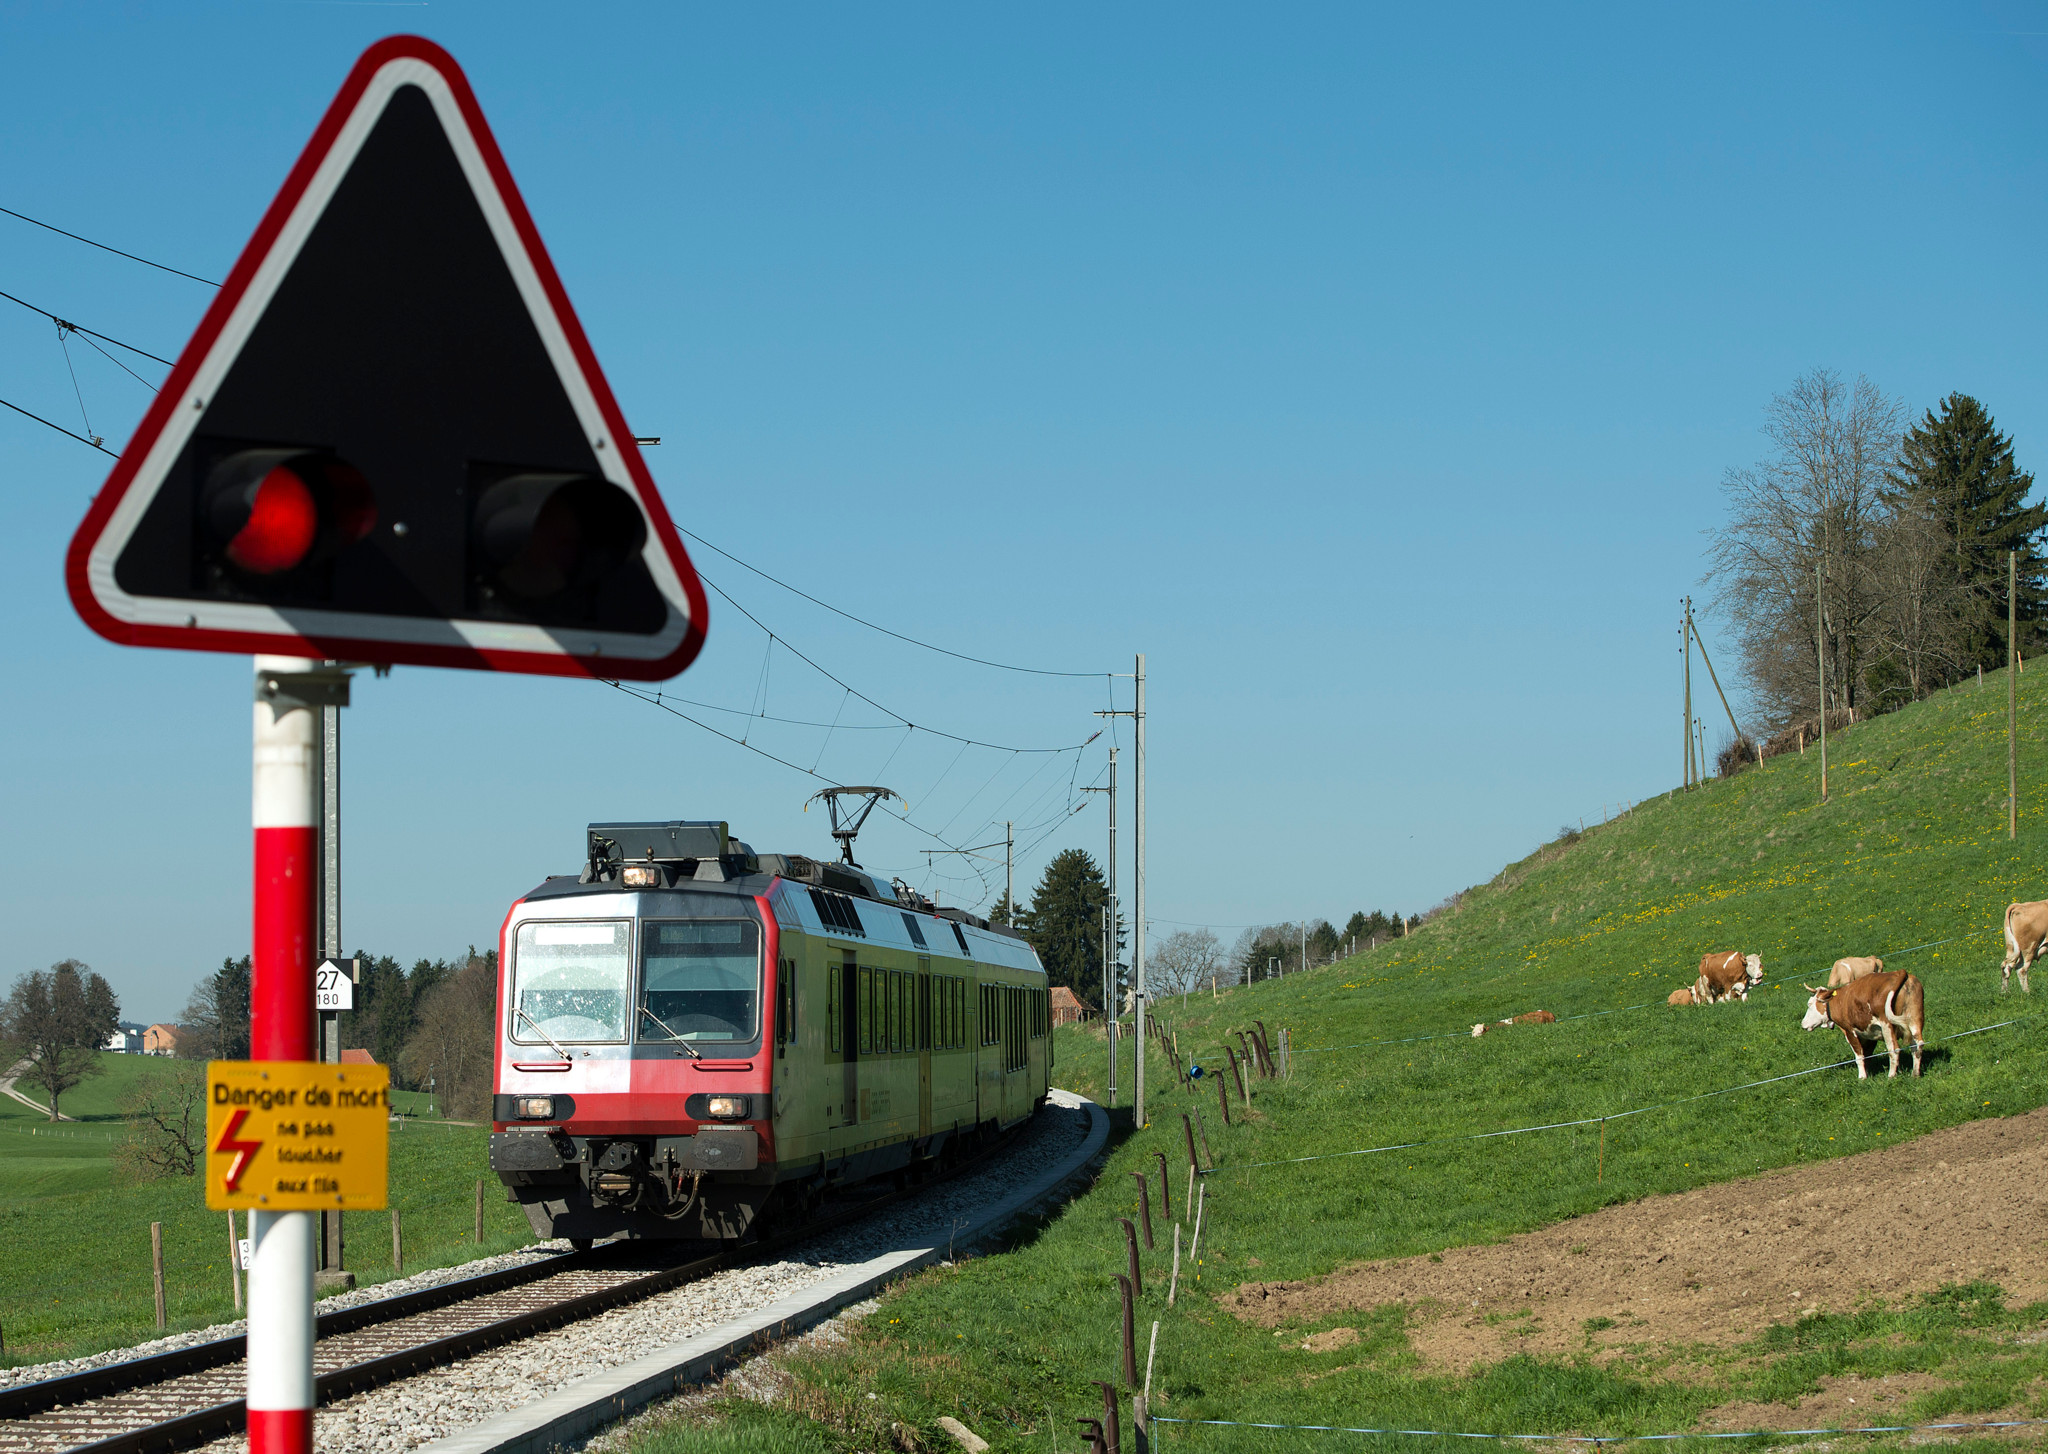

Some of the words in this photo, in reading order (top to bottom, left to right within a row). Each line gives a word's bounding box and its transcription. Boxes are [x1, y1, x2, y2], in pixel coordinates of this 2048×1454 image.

[317, 971, 339, 990] 27
[317, 994, 338, 1004] 180
[214, 1084, 297, 1110] Danger
[306, 1086, 331, 1106] de
[338, 1088, 388, 1107] mort
[277, 1122, 297, 1135] ne
[305, 1123, 334, 1138] pas
[278, 1148, 342, 1162] toucher
[277, 1180, 306, 1192] aux
